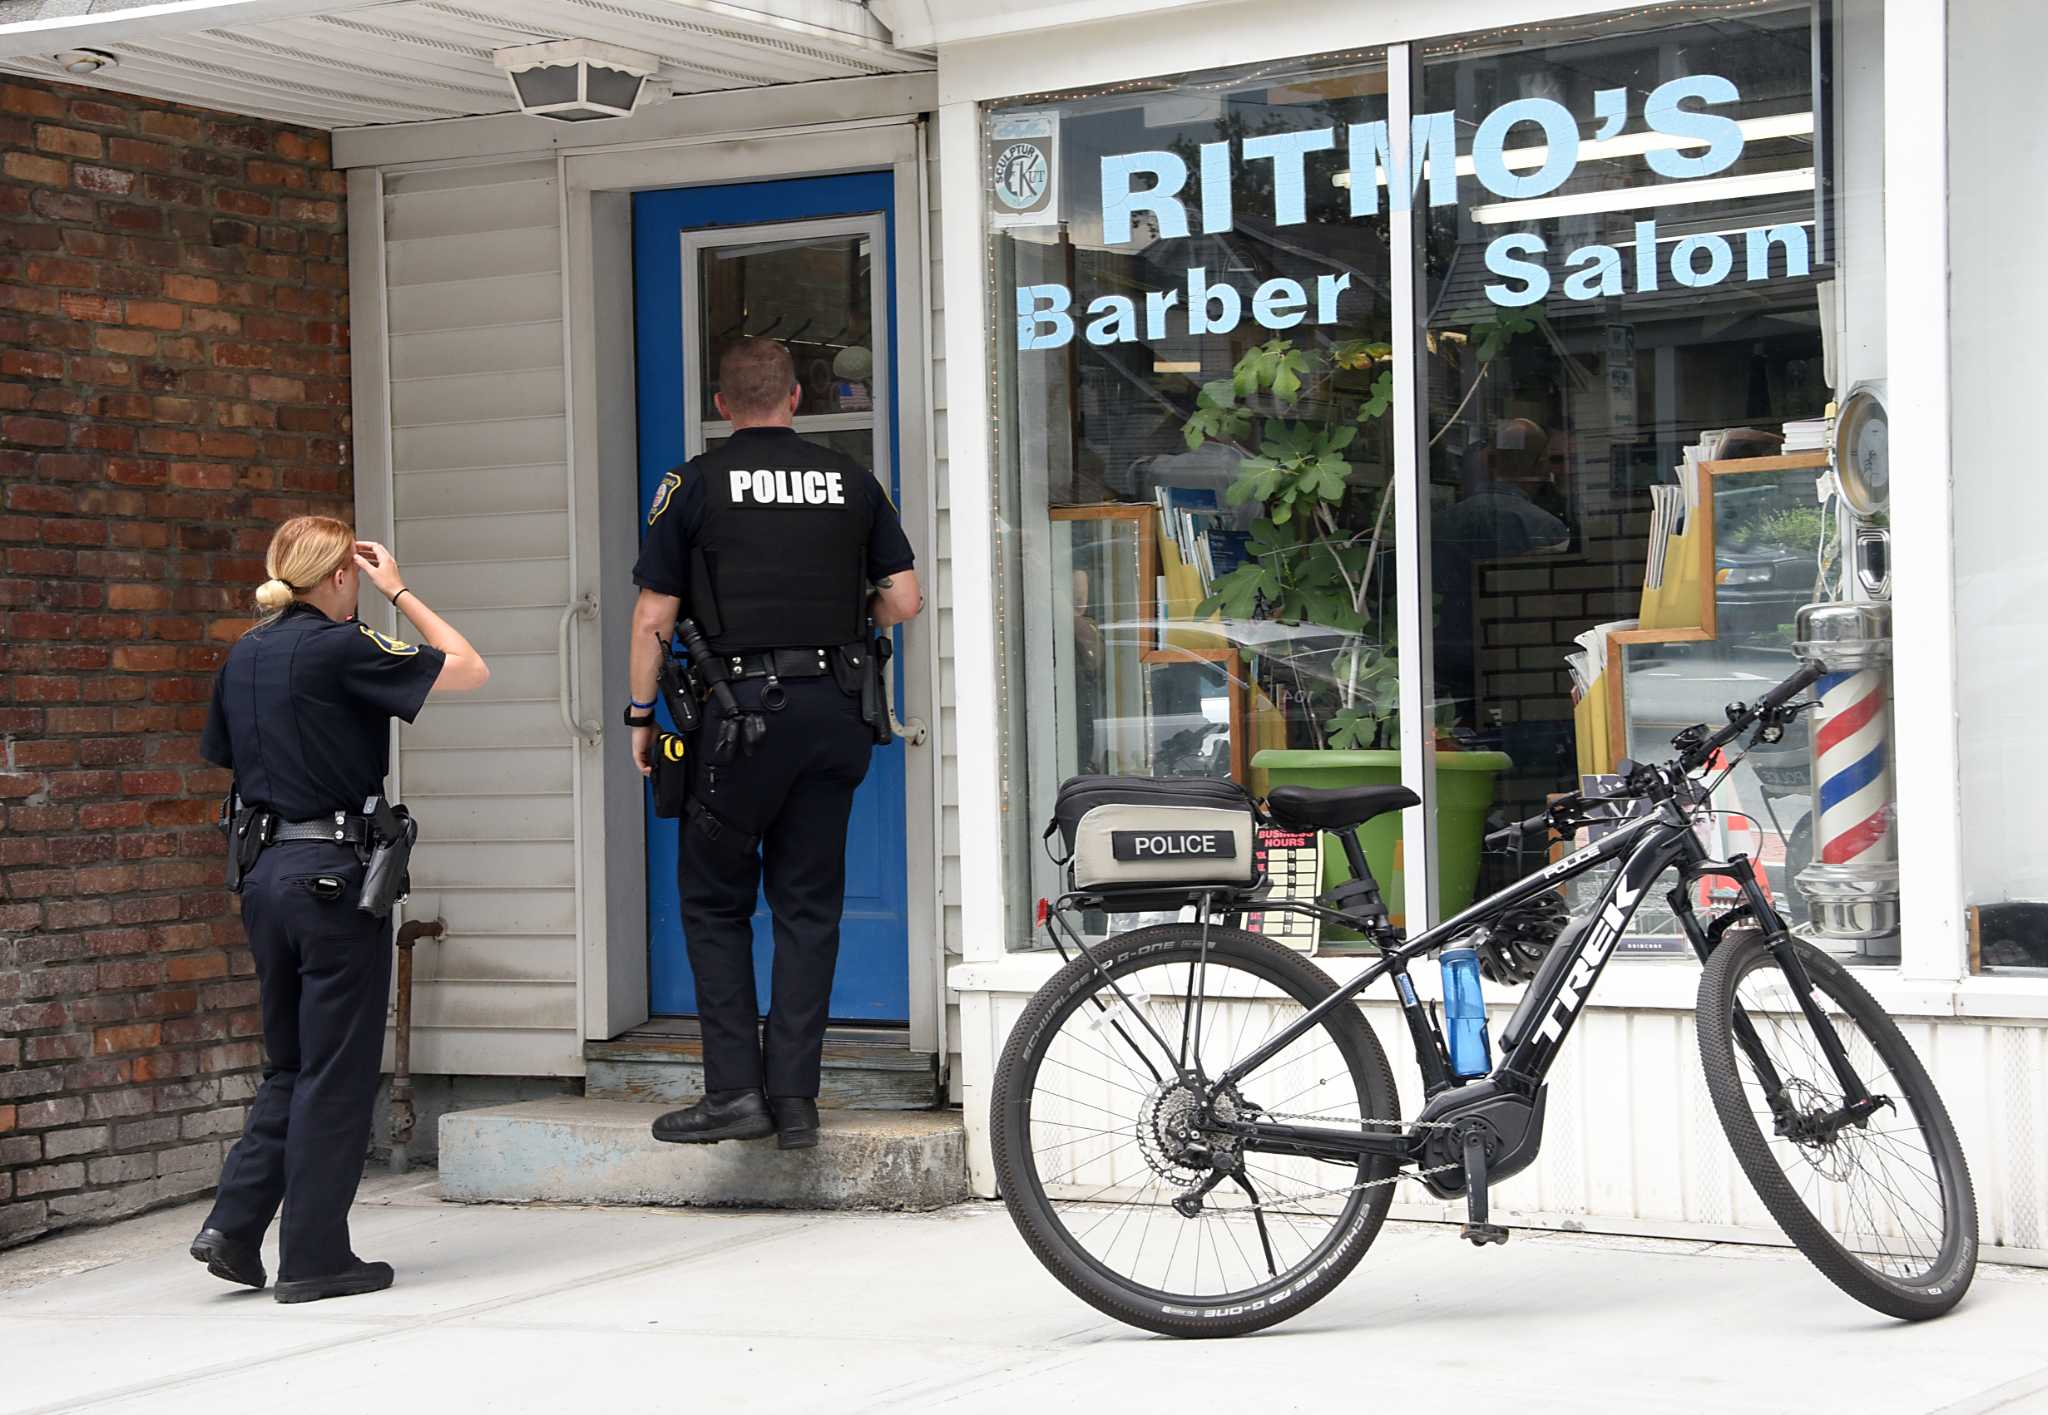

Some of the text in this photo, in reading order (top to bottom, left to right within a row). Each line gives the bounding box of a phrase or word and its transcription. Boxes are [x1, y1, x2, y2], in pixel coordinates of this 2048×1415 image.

[1484, 220, 1809, 307] Salon
[1017, 266, 1351, 350] Barber
[729, 469, 845, 504] POLICE
[1135, 835, 1217, 855] POLICE
[1264, 838, 1305, 847] HOURS
[1544, 846, 1600, 879] POLICE
[1532, 874, 1640, 1044] TREK
[1295, 1203, 1370, 1290] SCHWALBE
